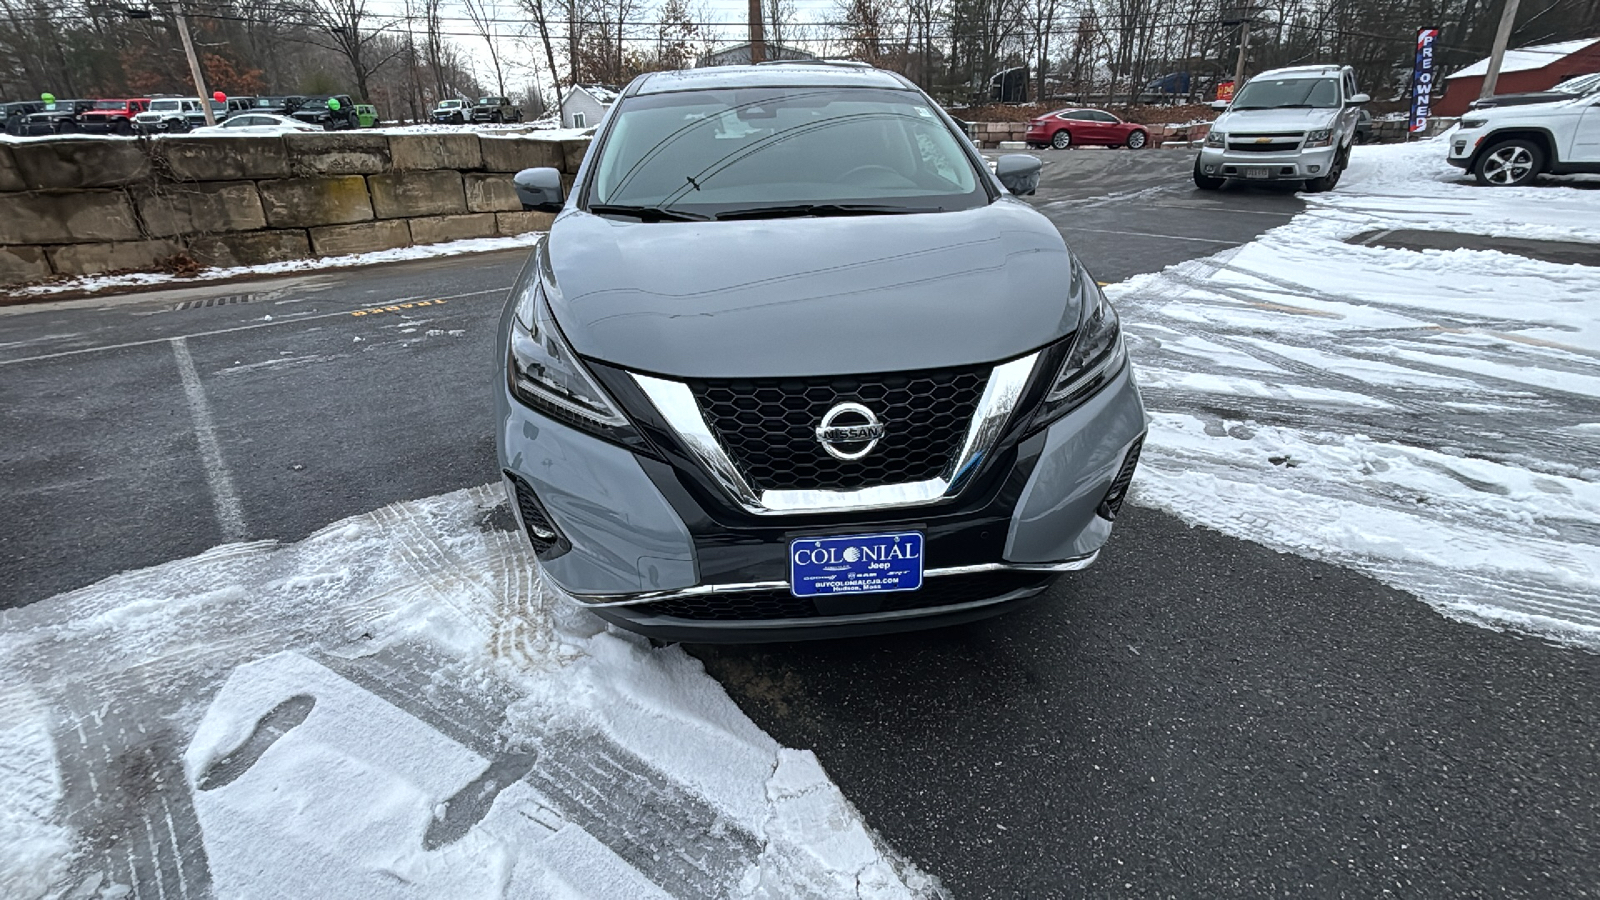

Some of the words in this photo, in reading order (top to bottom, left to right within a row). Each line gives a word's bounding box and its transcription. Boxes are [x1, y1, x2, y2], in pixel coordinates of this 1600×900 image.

[1423, 36, 1433, 69] PRE
[1416, 73, 1431, 126] OWNED
[823, 427, 878, 439] NISSAN
[794, 542, 919, 566] COLONIAL
[867, 561, 891, 571] Jeep
